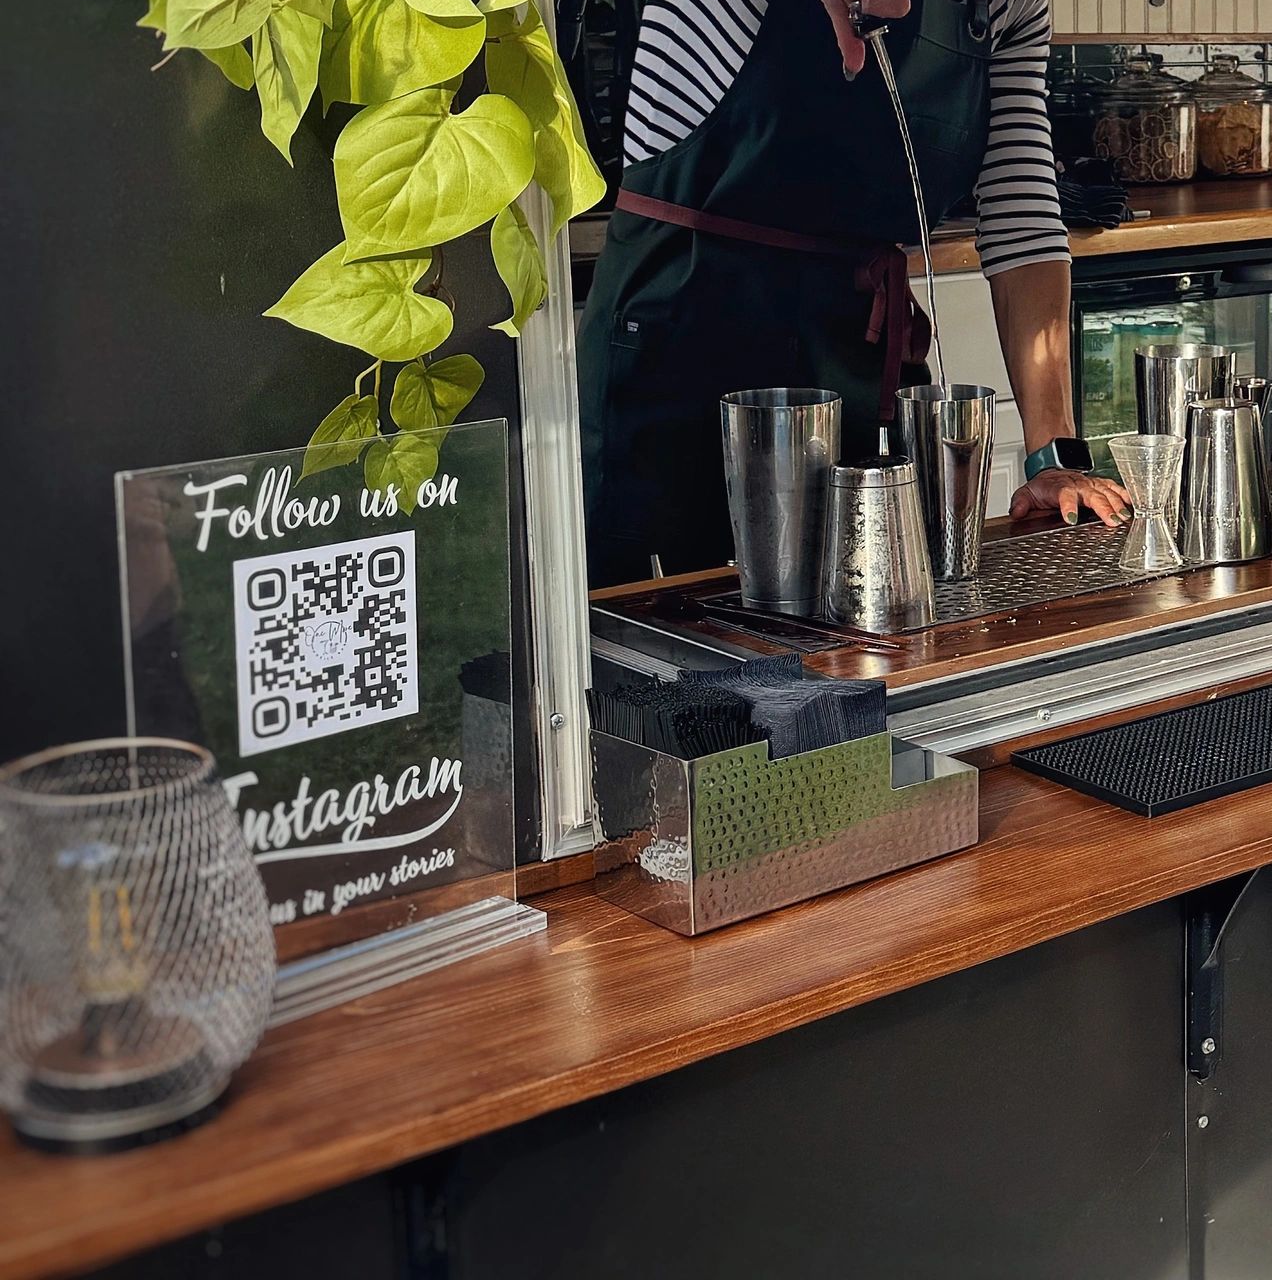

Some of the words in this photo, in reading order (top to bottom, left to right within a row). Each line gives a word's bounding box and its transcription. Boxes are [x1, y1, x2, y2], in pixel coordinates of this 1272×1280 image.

[183, 465, 341, 552] Follow
[359, 483, 401, 518] us
[417, 473, 460, 509] on
[303, 888, 326, 915] in
[330, 871, 387, 916] your
[389, 847, 457, 887] stories
